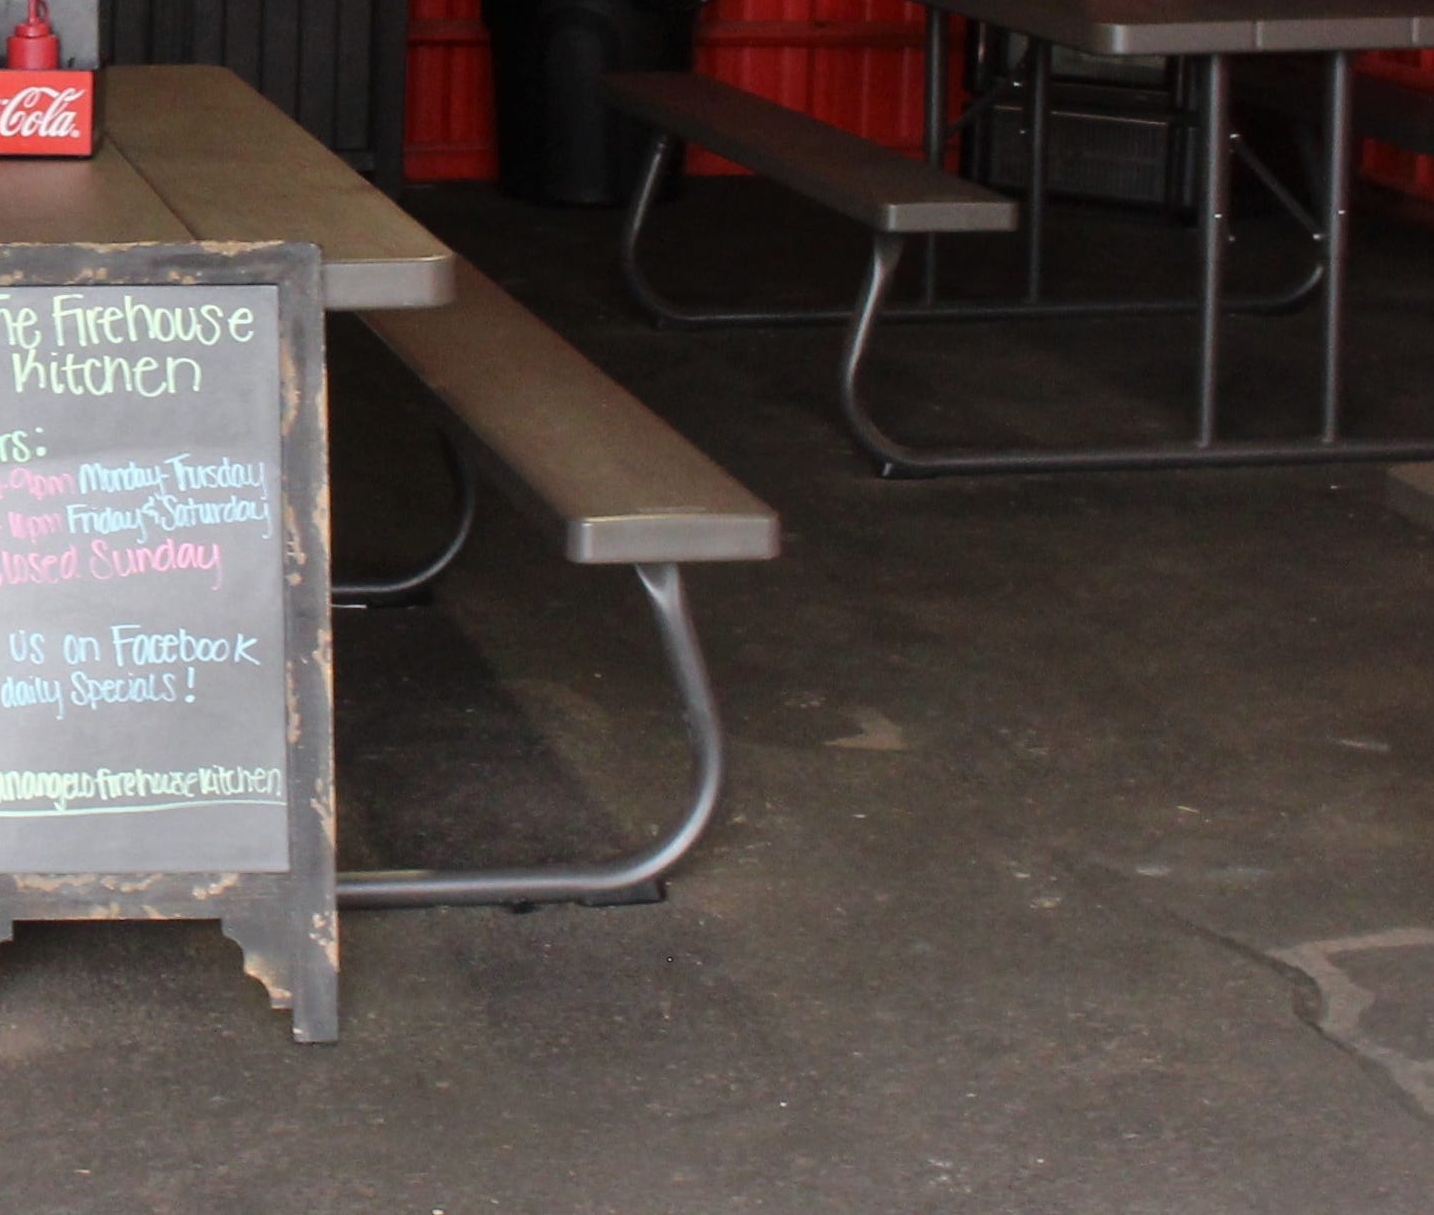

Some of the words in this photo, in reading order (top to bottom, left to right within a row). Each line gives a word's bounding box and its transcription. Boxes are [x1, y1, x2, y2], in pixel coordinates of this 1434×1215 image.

[52, 294, 254, 347] Firehouse
[12, 351, 202, 397] Kitchen
[90, 539, 222, 591] Sunday
[63, 633, 100, 665] on
[110, 624, 261, 667] Facebook
[1, 675, 65, 720] daily
